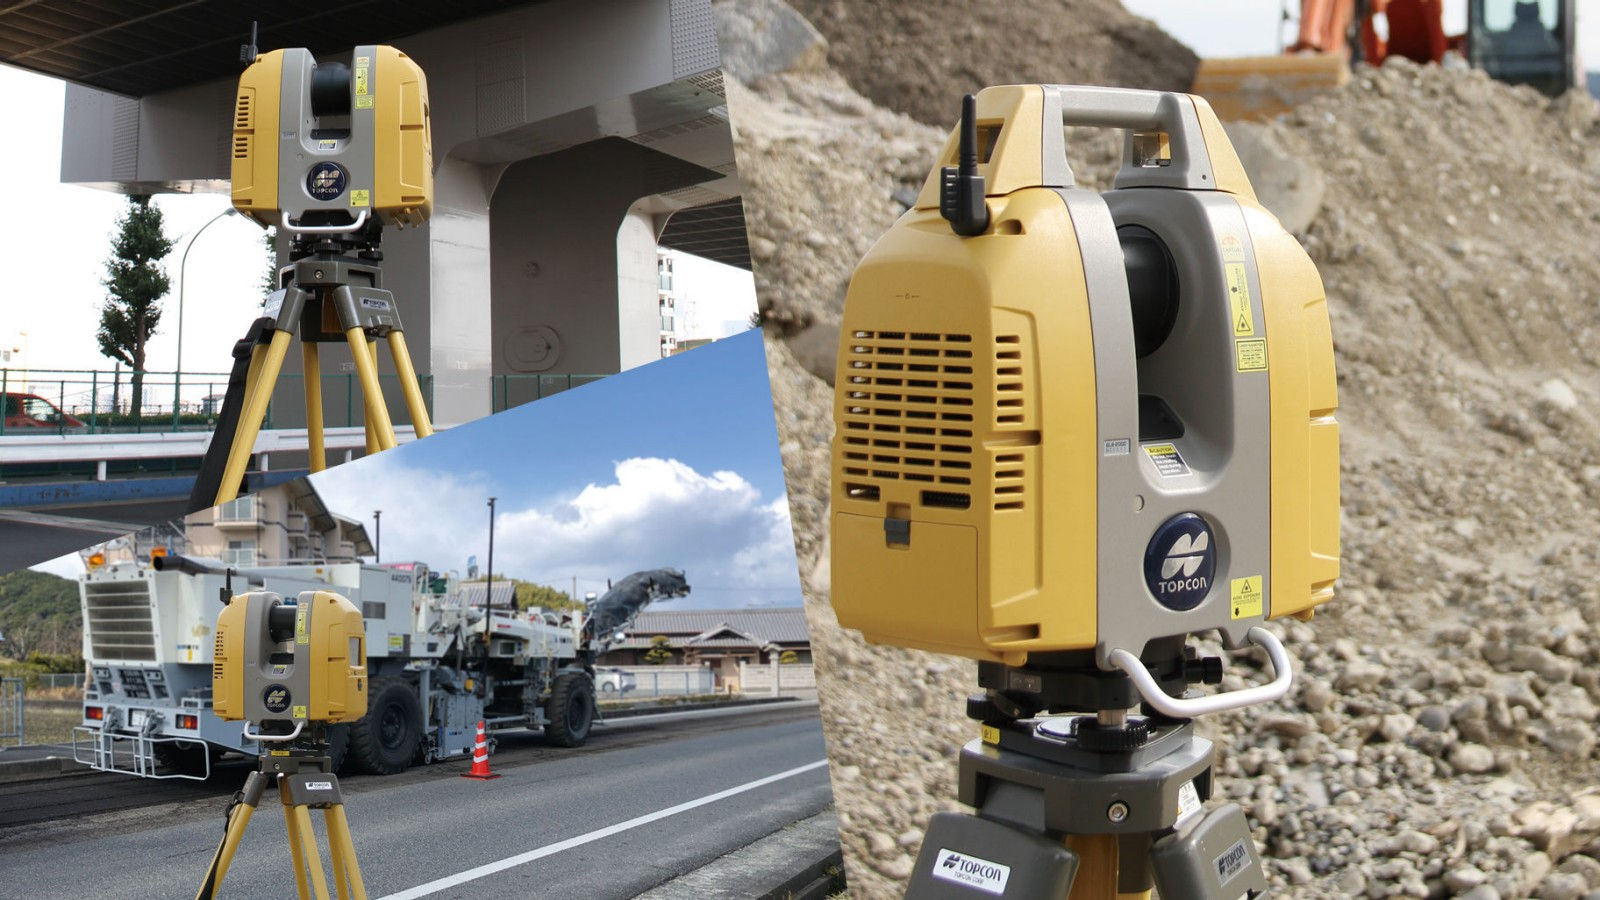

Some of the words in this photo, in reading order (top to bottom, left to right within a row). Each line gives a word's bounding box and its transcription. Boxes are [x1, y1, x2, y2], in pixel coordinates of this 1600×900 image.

[1158, 577, 1207, 594] TOPCON
[1224, 844, 1246, 868] TOPCON
[960, 859, 1002, 882] TOPCON
